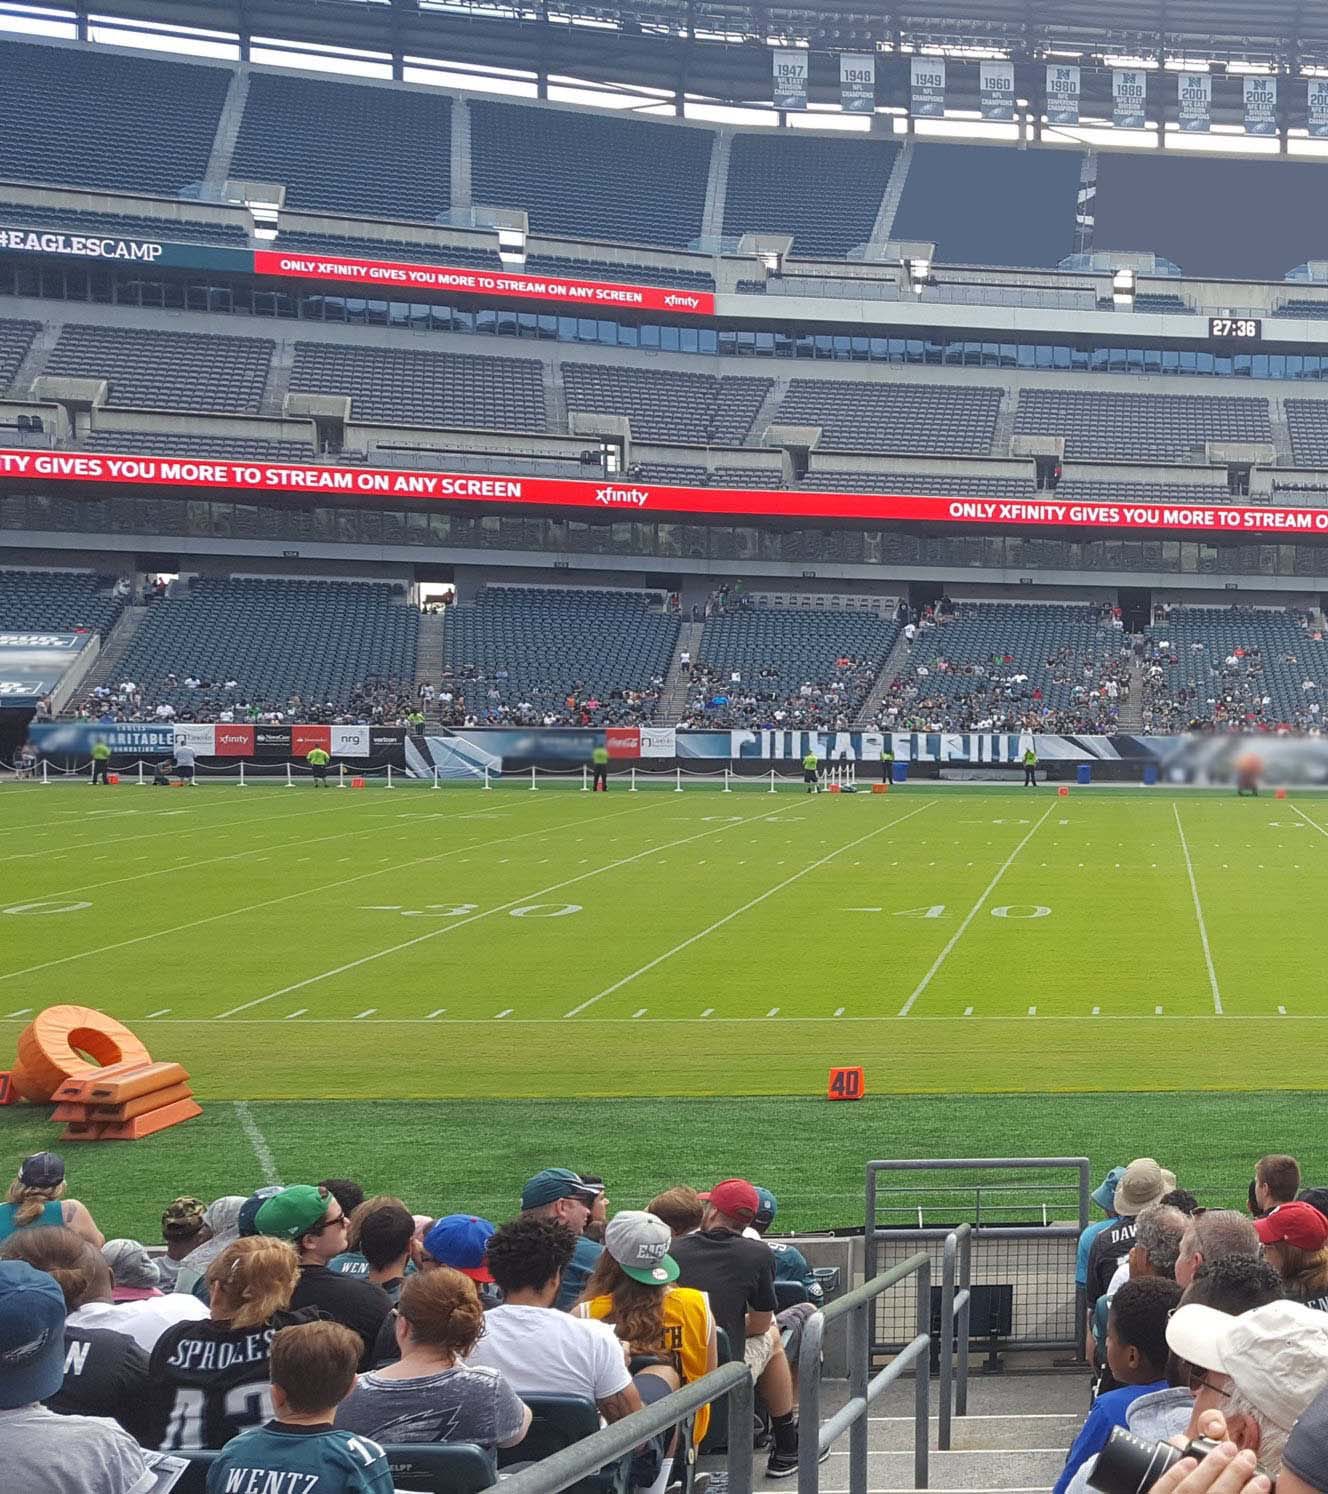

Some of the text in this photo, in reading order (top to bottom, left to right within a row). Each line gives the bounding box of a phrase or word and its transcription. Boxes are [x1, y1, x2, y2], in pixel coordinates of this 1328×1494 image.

[777, 64, 804, 76] 1947
[844, 69, 871, 82] 1948
[915, 73, 942, 86] 1949
[984, 77, 1010, 90] 1960
[1051, 80, 1076, 93] 1980
[1117, 84, 1142, 96] 1988
[1182, 88, 1207, 100] 2001
[1246, 91, 1273, 103] 2002
[280, 259, 642, 303] ONLY XFINITY GIVES YOU MORE TO STREAM ON ANY SCREEN
[664, 294, 699, 308] xfinity
[1212, 319, 1256, 337] 27:36
[35, 456, 102, 476] GIVES
[106, 460, 155, 479] YOU
[161, 463, 227, 482] MORE
[232, 466, 261, 484] TO
[265, 468, 353, 489] STREAM
[357, 473, 389, 491] ON
[394, 475, 437, 493] ANY
[441, 478, 521, 498] SCREEN
[595, 488, 648, 506] xfinity
[949, 502, 996, 519] ONLY
[999, 504, 1065, 521] XFINITY
[1069, 507, 1119, 523] GIVES
[1123, 508, 1160, 524] YOU
[1164, 510, 1214, 526] MORE
[1218, 511, 1241, 526] TO
[1244, 512, 1312, 529] STREAM
[219, 734, 248, 745] xfinity
[341, 735, 360, 746] nrg
[831, 1070, 859, 1096] 40
[167, 1328, 276, 1370] SPROLES
[224, 1467, 320, 1494] WENTZ
